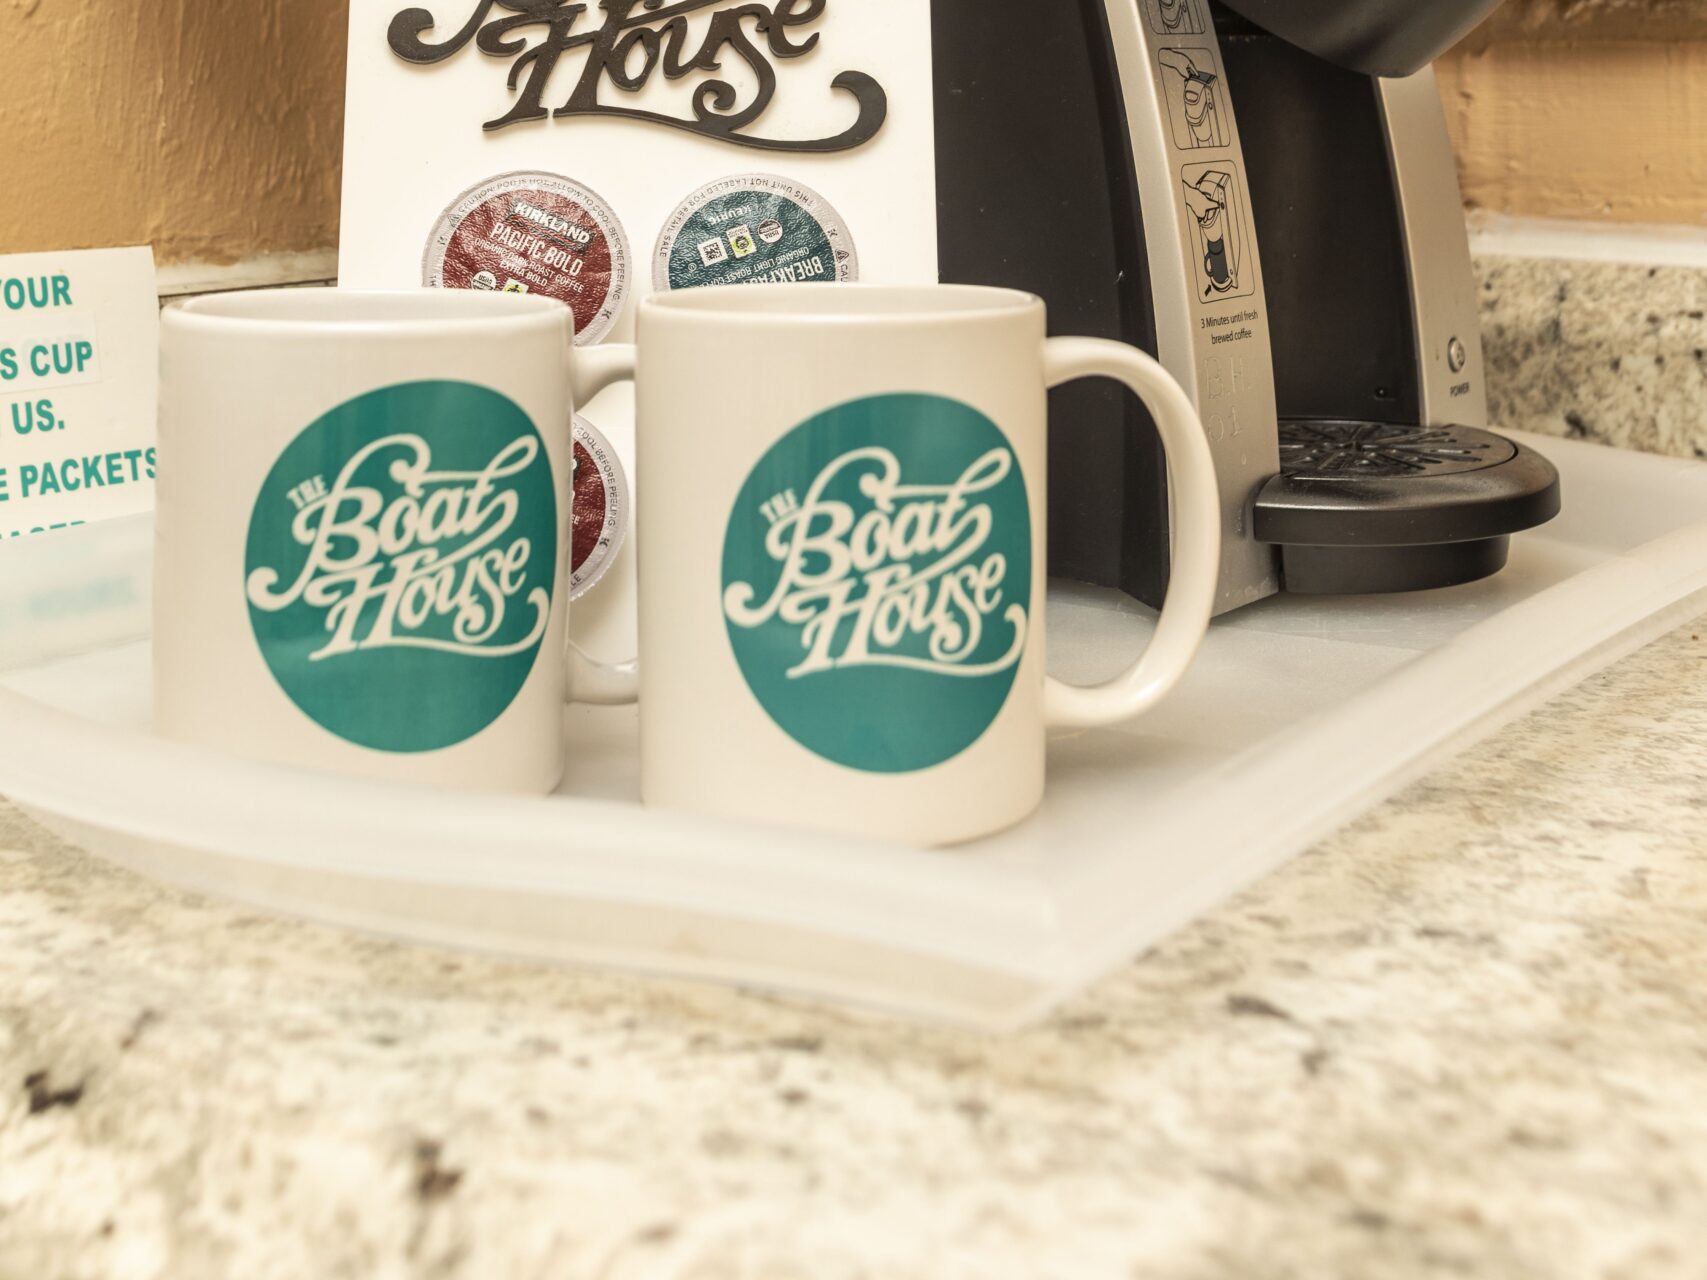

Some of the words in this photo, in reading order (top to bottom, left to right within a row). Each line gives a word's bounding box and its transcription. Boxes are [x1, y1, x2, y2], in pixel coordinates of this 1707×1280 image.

[687, 192, 707, 207] FOR
[749, 177, 769, 187] NOT
[771, 183, 793, 194] UNIT
[791, 189, 814, 207] THIS
[514, 201, 590, 244] KIRKLAND
[668, 206, 690, 233] RETAIL
[707, 204, 753, 226] KEURIG
[490, 222, 546, 260] PACIFIC
[543, 246, 583, 277] BOLD
[608, 226, 625, 262] BEFORE
[660, 235, 671, 257] SALE
[775, 246, 810, 266] ORGANIC
[499, 260, 526, 278] EXTRA
[526, 270, 549, 288] BOLD
[530, 259, 555, 279] ROAST
[555, 272, 585, 294] COFFEE
[612, 262, 625, 301] PEELING
[742, 256, 825, 285] BREAKFA
[753, 258, 777, 273] LIGHT
[0, 274, 73, 311] OUR
[1200, 318, 1206, 330] 3
[1206, 315, 1230, 329] Minutes
[1230, 311, 1244, 324] until
[1243, 309, 1259, 321] fresh
[1211, 330, 1234, 345] brewed
[1234, 327, 1253, 341] coffee
[30, 340, 93, 377] CUP
[11, 398, 66, 436] US.
[19, 446, 156, 499] PACKETS
[595, 449, 616, 485] BEFORE
[608, 485, 618, 527] PEELING
[286, 473, 329, 509] THE
[760, 487, 800, 524] THE
[247, 432, 539, 612] Boat
[723, 446, 1012, 627] Boat
[304, 536, 550, 662] House
[779, 552, 1028, 680] House
